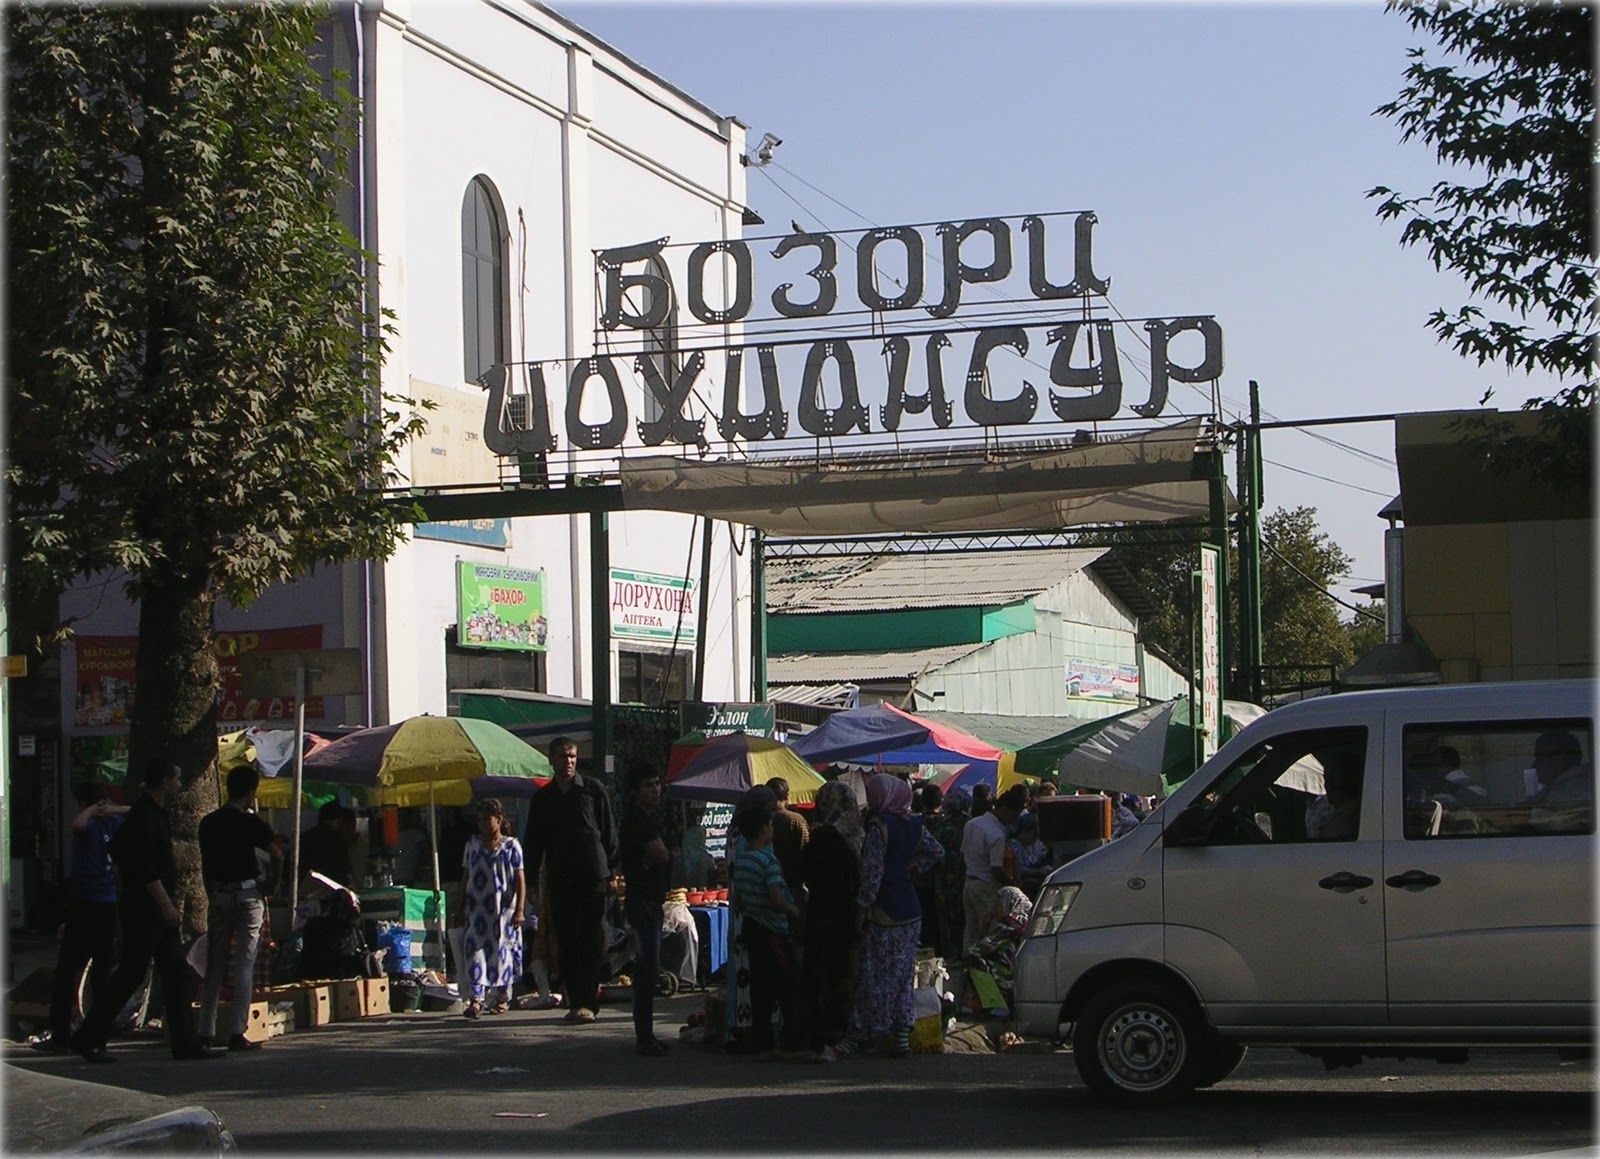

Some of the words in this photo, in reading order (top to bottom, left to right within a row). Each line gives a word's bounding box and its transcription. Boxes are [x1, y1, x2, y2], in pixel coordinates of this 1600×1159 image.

[597, 211, 1110, 329] БОЗОРИ
[613, 582, 693, 613] ДОРУХОНА
[622, 613, 663, 627] АПТЕКА
